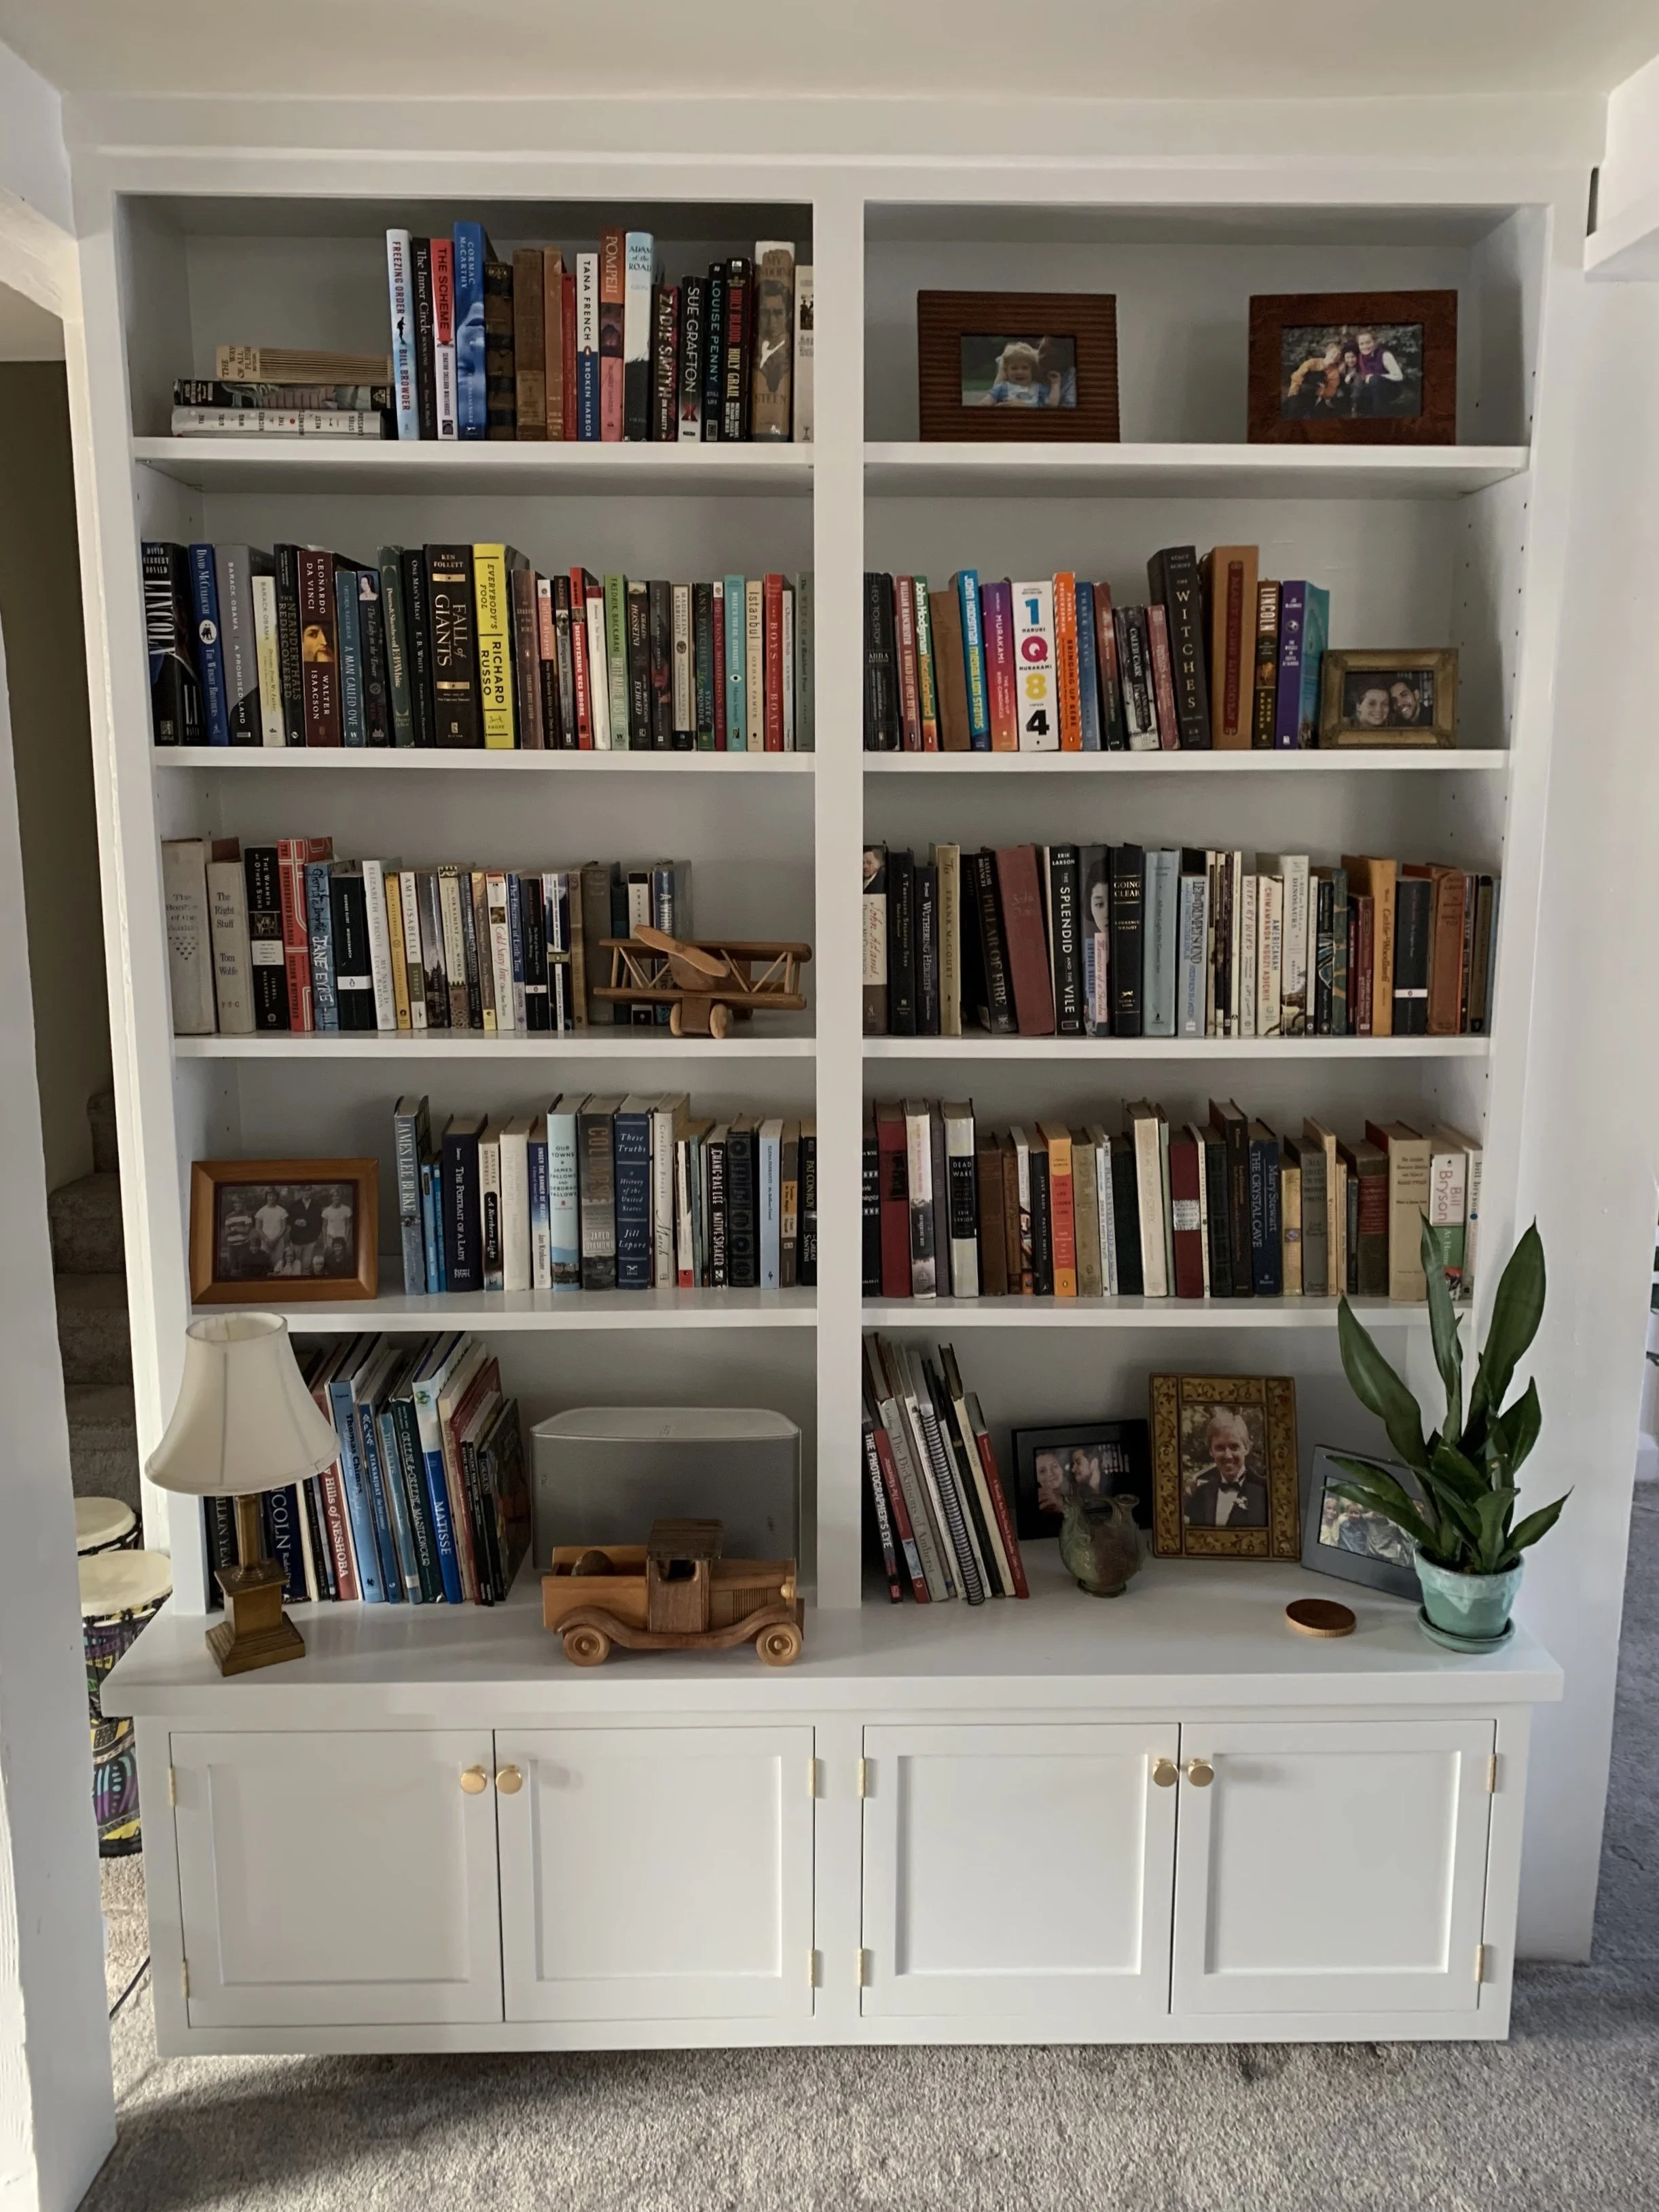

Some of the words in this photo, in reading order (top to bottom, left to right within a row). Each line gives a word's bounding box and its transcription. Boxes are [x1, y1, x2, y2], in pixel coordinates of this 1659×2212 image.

[393, 242, 403, 283] FREEZING
[416, 249, 427, 268] The
[438, 248, 448, 272] THE
[606, 236, 617, 293] POMPEII
[395, 286, 405, 314] ORDER
[418, 272, 428, 300] Inner
[687, 287, 699, 315] SUE
[419, 302, 430, 333] Circle
[439, 276, 449, 329] SCHEME
[659, 294, 673, 341] ZADIE
[712, 280, 721, 331] LOUISE
[399, 349, 408, 367] BILL
[659, 345, 672, 398] SMITH
[685, 320, 697, 392] GRAFTON
[710, 336, 719, 382] PENNY
[401, 369, 410, 410] BROWDER
[306, 563, 312, 576] DA
[317, 559, 325, 614] LEONARDO
[487, 564, 497, 629] EVERYBODY'S
[610, 578, 619, 611] FREDRIK
[915, 582, 926, 605] John
[145, 581, 176, 655] LINCOLN
[230, 600, 238, 630] OBAMA
[452, 604, 467, 646] FALL
[632, 604, 640, 646] HOSSEINI
[749, 592, 760, 639] Istanbul
[872, 606, 881, 645] TOLSTOY
[1260, 587, 1277, 632] LINCOLN
[435, 594, 452, 666] GIANTS
[917, 606, 929, 655] Hodgman
[278, 603, 291, 698] REDISCOVERED
[287, 603, 301, 700] NEANDERTHALS
[345, 655, 354, 674] MAN
[456, 648, 467, 658] of
[235, 654, 243, 698] PROMISED
[481, 650, 491, 695] RUSSO
[492, 641, 505, 704] RICHARD
[310, 670, 319, 719] ISAACSON
[322, 675, 330, 715] WALTER
[346, 678, 357, 706] CALLED
[1069, 688, 1075, 700] UP
[348, 710, 357, 726] OVE
[215, 905, 235, 915] Right
[217, 892, 231, 901] The
[1291, 877, 1299, 929] DINOSAURS
[217, 920, 234, 928] Stuff
[406, 909, 416, 956] ISABELLE
[982, 894, 997, 943] PILLAR
[1060, 887, 1072, 953] SPLENDID
[219, 954, 235, 962] Tom
[312, 935, 329, 971] JANE
[989, 951, 1002, 969] OF
[1272, 920, 1280, 971] AMERICANAH
[219, 966, 239, 976] Wolfe
[316, 973, 334, 1003] EYRE
[992, 973, 1007, 1007] FIRE
[1064, 985, 1074, 1013] VILE
[397, 1122, 412, 1155] JAMES
[617, 1144, 646, 1153] Truths
[620, 1134, 644, 1142] These
[401, 1158, 414, 1177] LEE
[456, 1167, 464, 1183] THE
[588, 1127, 610, 1203] COLLAPSE
[711, 1148, 723, 1190] CHANG-RAE
[1251, 1151, 1261, 1173] THE
[1267, 1165, 1277, 1191] Mary
[401, 1181, 416, 1212] BURKE
[456, 1185, 466, 1220] PORTRAIT
[488, 1197, 495, 1207] A
[712, 1192, 723, 1205] LEE
[806, 1176, 815, 1209] CONROY
[1252, 1176, 1262, 1218] CRYSTAL
[1436, 1170, 1453, 1221] Bryson
[1450, 1186, 1462, 1205] Bill
[456, 1223, 464, 1233] OF
[488, 1209, 496, 1237] Northern
[712, 1212, 723, 1235] NATIVE
[1269, 1193, 1277, 1233] Stewart
[488, 1239, 496, 1258] Light
[618, 1239, 646, 1249] Lepore
[623, 1229, 640, 1237] Jill
[656, 1210, 671, 1256] March
[1252, 1218, 1262, 1248] CAVE
[1443, 1229, 1451, 1238] At
[457, 1241, 466, 1261] LADY
[714, 1236, 725, 1266] SPEAKER
[1442, 1241, 1451, 1265] Home
[346, 1413, 359, 1454] Thomas
[864, 1432, 874, 1452] THE
[891, 1434, 905, 1457] The
[326, 1478, 338, 1504] Hills
[352, 1456, 363, 1494] Chimes
[868, 1452, 888, 1530] PHOTOGRAPHER'S
[896, 1457, 917, 1515] Dickinsons
[328, 1506, 340, 1519] of
[433, 1501, 451, 1555] MATISSE
[913, 1516, 925, 1527] of
[332, 1521, 348, 1578] NESHOBA
[879, 1531, 892, 1549] EYE
[916, 1531, 936, 1574] Amherst
